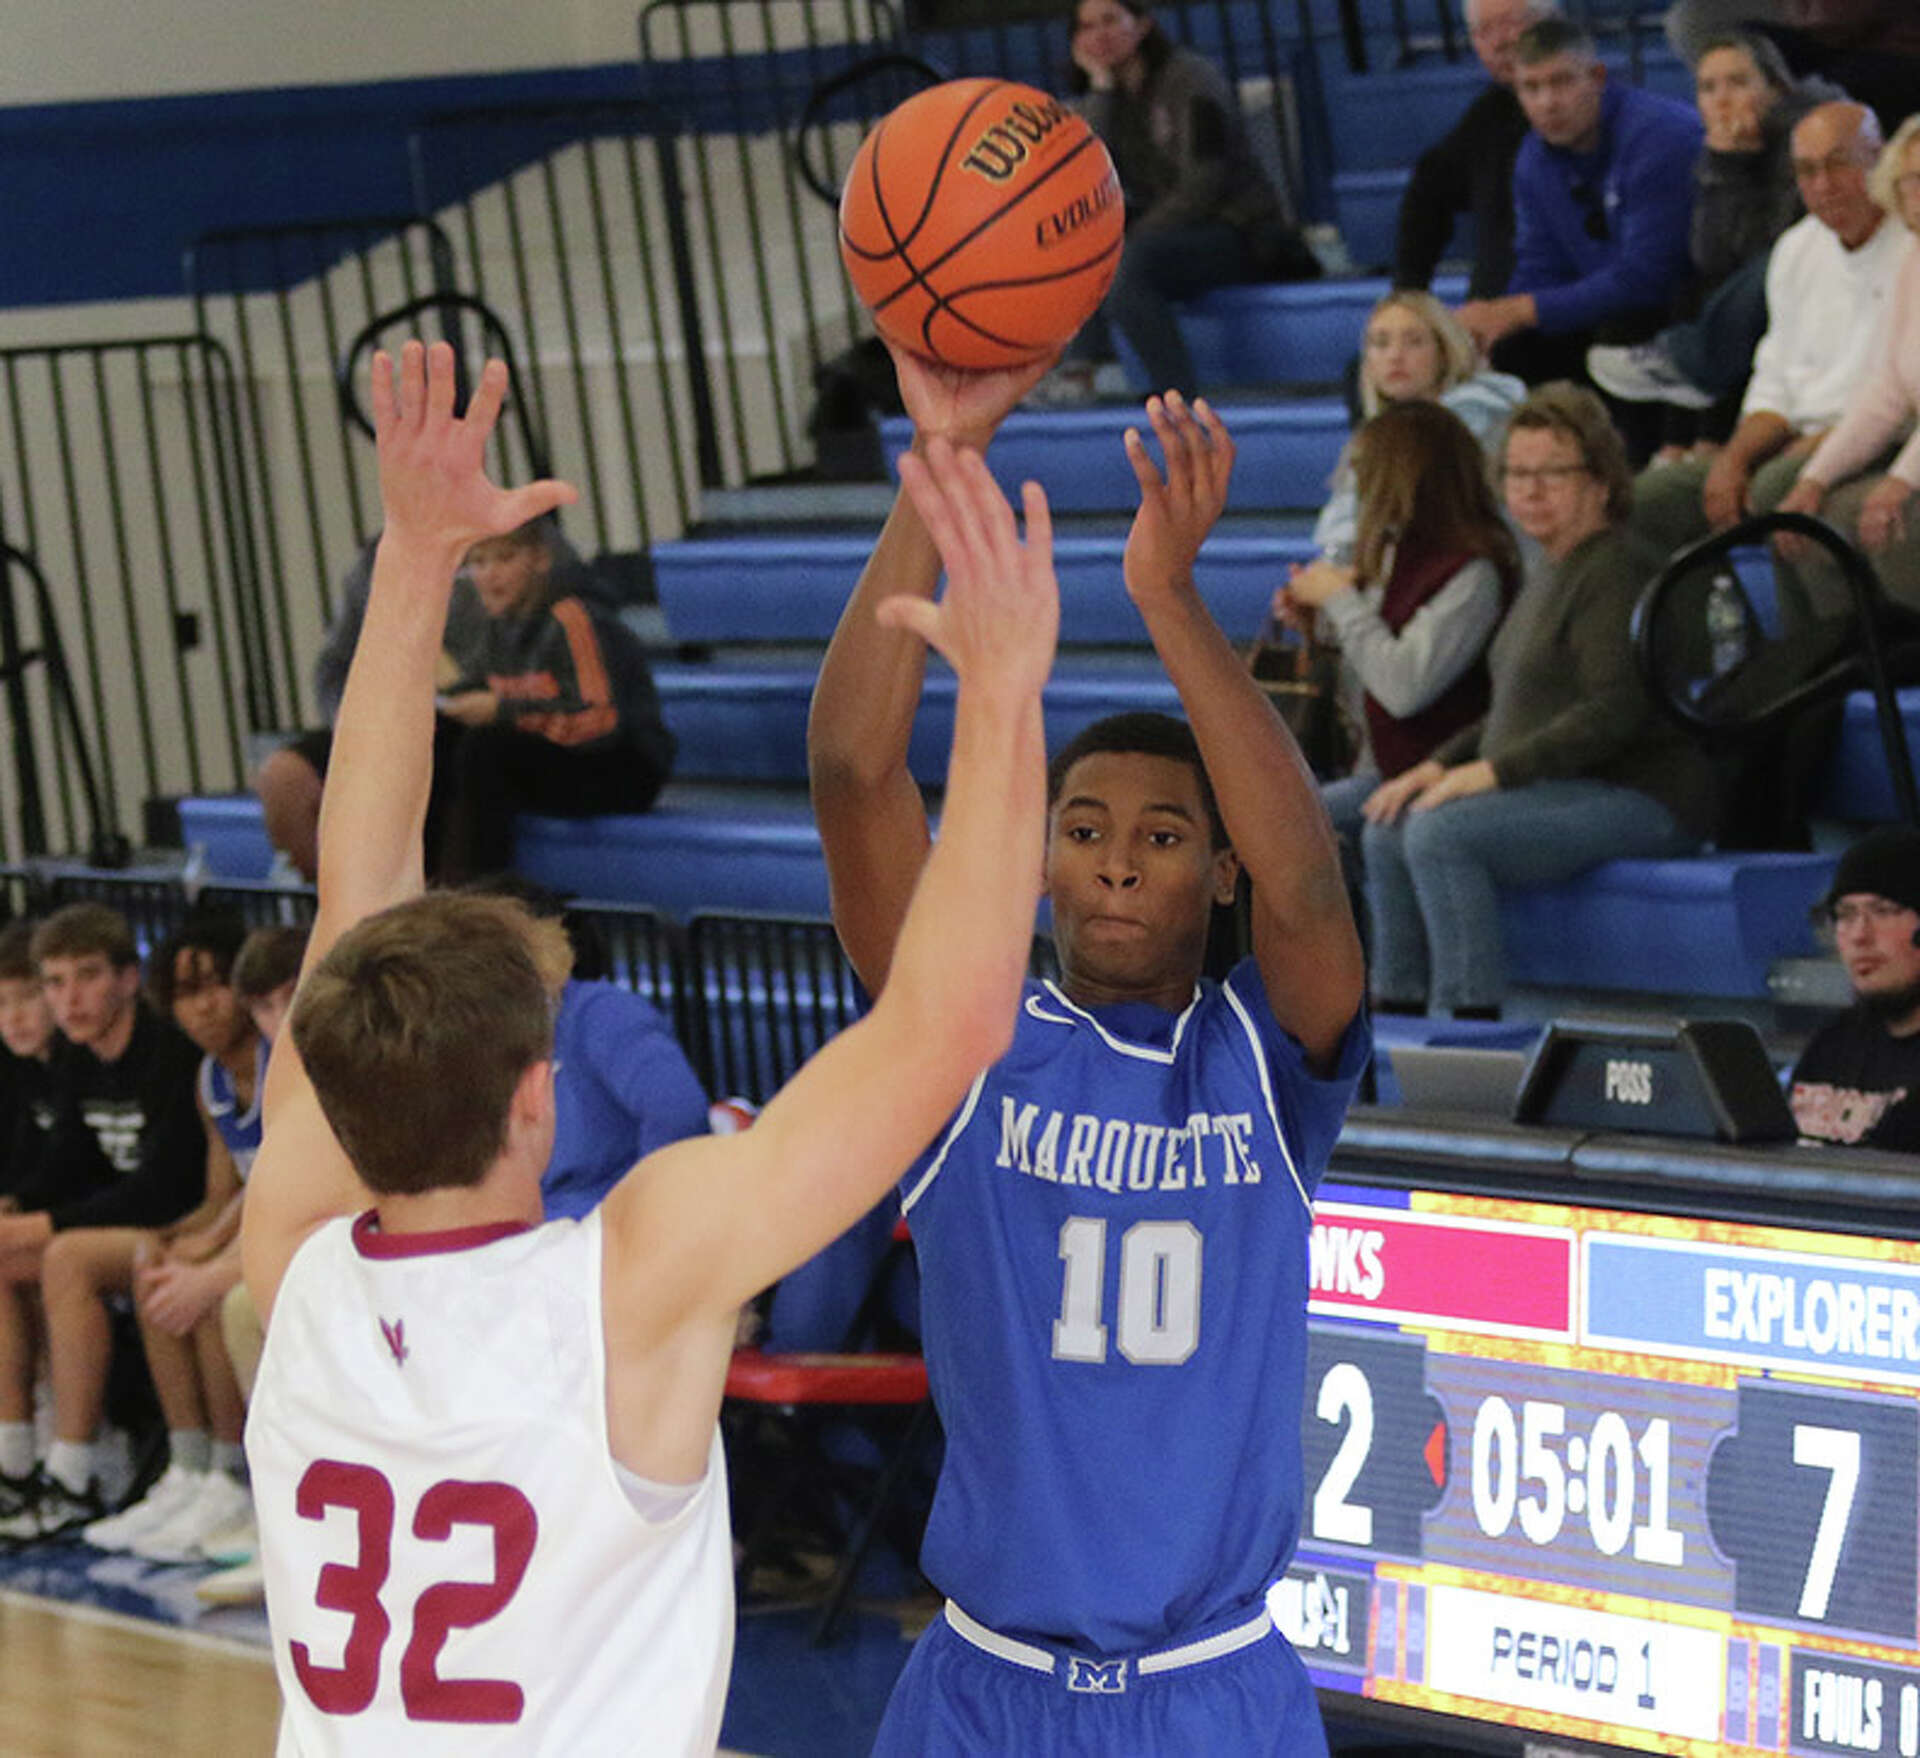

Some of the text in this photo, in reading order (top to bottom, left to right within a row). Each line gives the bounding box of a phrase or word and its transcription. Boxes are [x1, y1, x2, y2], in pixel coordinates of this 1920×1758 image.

[1606, 1060, 1652, 1104] POSS
[996, 1096, 1262, 1194] MARQUETTE
[1051, 1215, 1203, 1366] 10
[1312, 1362, 1374, 1545] 2
[1472, 1395, 1684, 1566] 05:01
[1793, 1424, 1861, 1619] 7
[290, 1459, 538, 1724] 32
[1067, 1657, 1126, 1693] M
[1491, 1626, 1618, 1693] PERIOD
[1638, 1641, 1655, 1709] 1
[1803, 1669, 1882, 1751] FOULS
